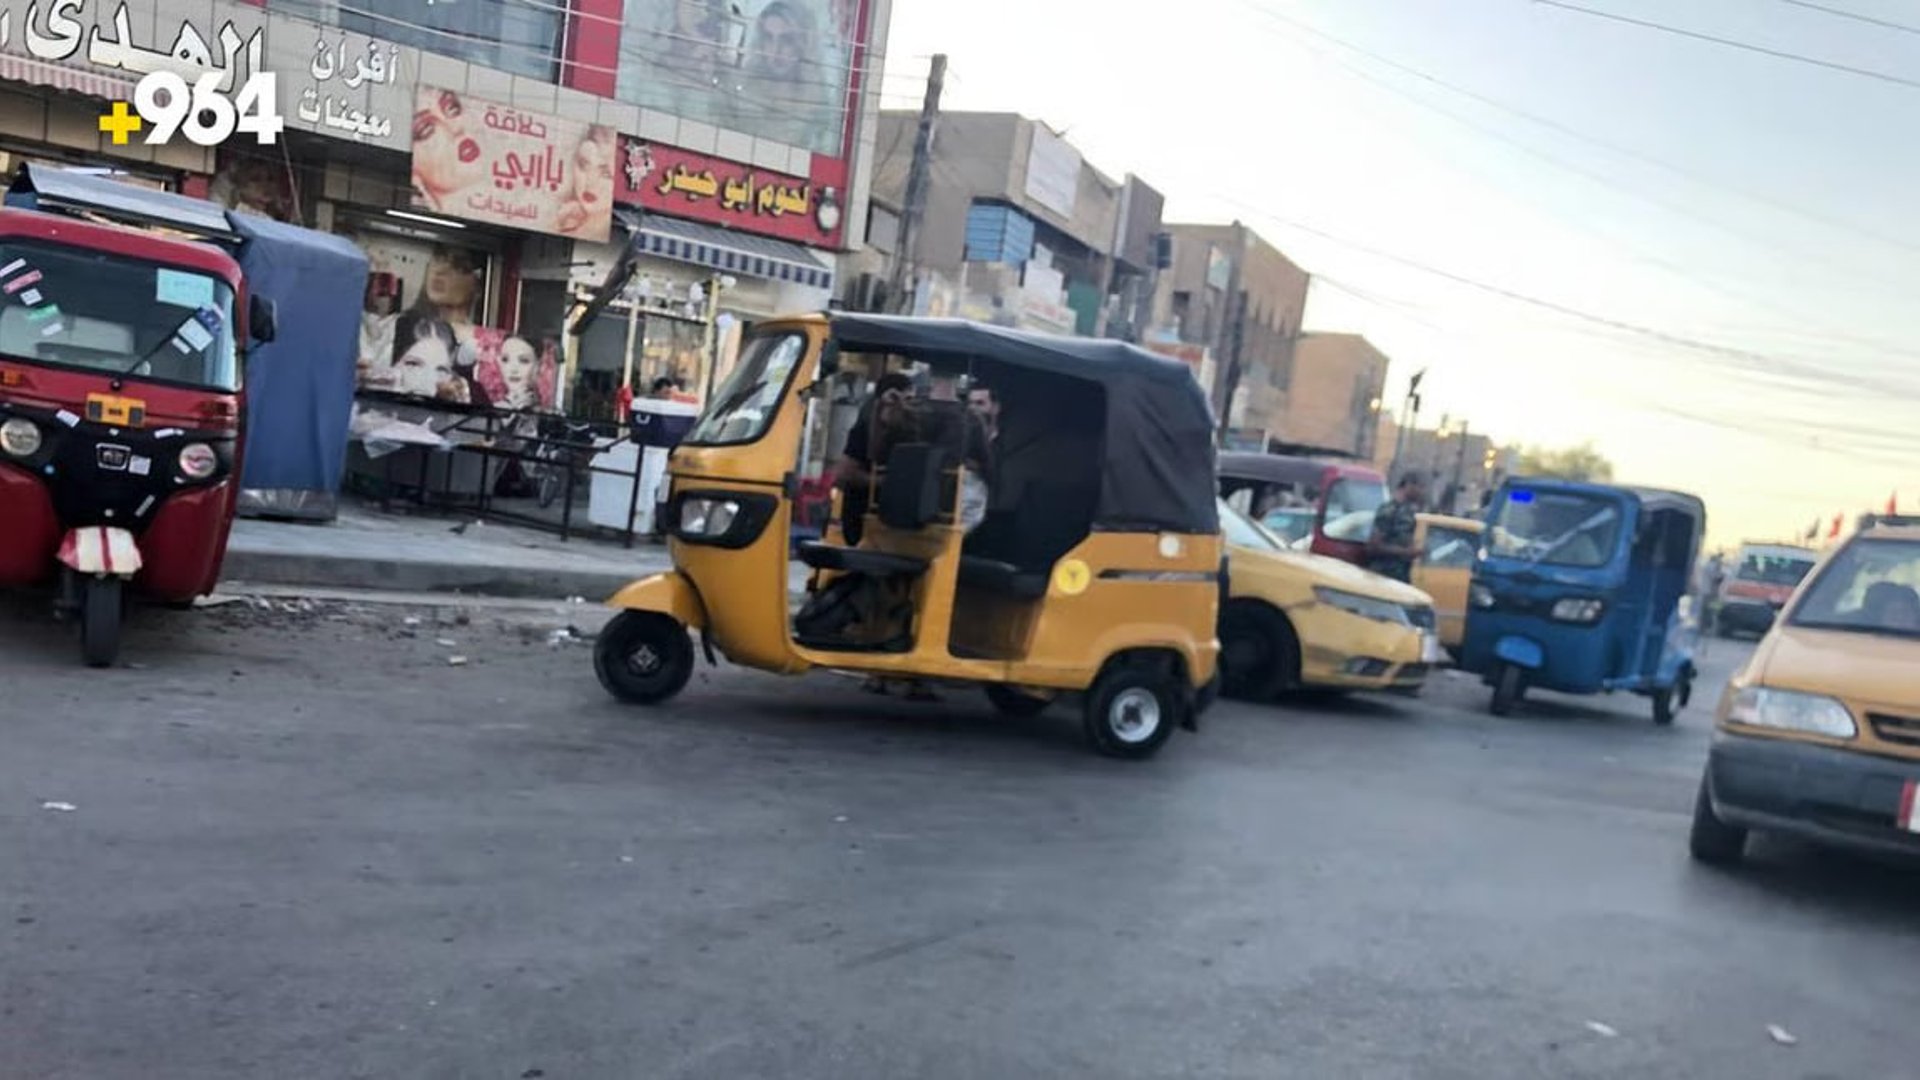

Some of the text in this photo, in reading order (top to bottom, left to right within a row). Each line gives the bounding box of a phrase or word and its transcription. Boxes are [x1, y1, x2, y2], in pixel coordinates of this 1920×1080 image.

[25, 0, 264, 95] الهدى
[311, 41, 398, 88] أفران
[299, 89, 391, 140] معجنات
[484, 105, 546, 138] حلاقة
[492, 145, 563, 191] باربي
[657, 164, 718, 201] حيدر
[467, 192, 537, 219] للسيدات
[757, 184, 809, 216] لحوم
